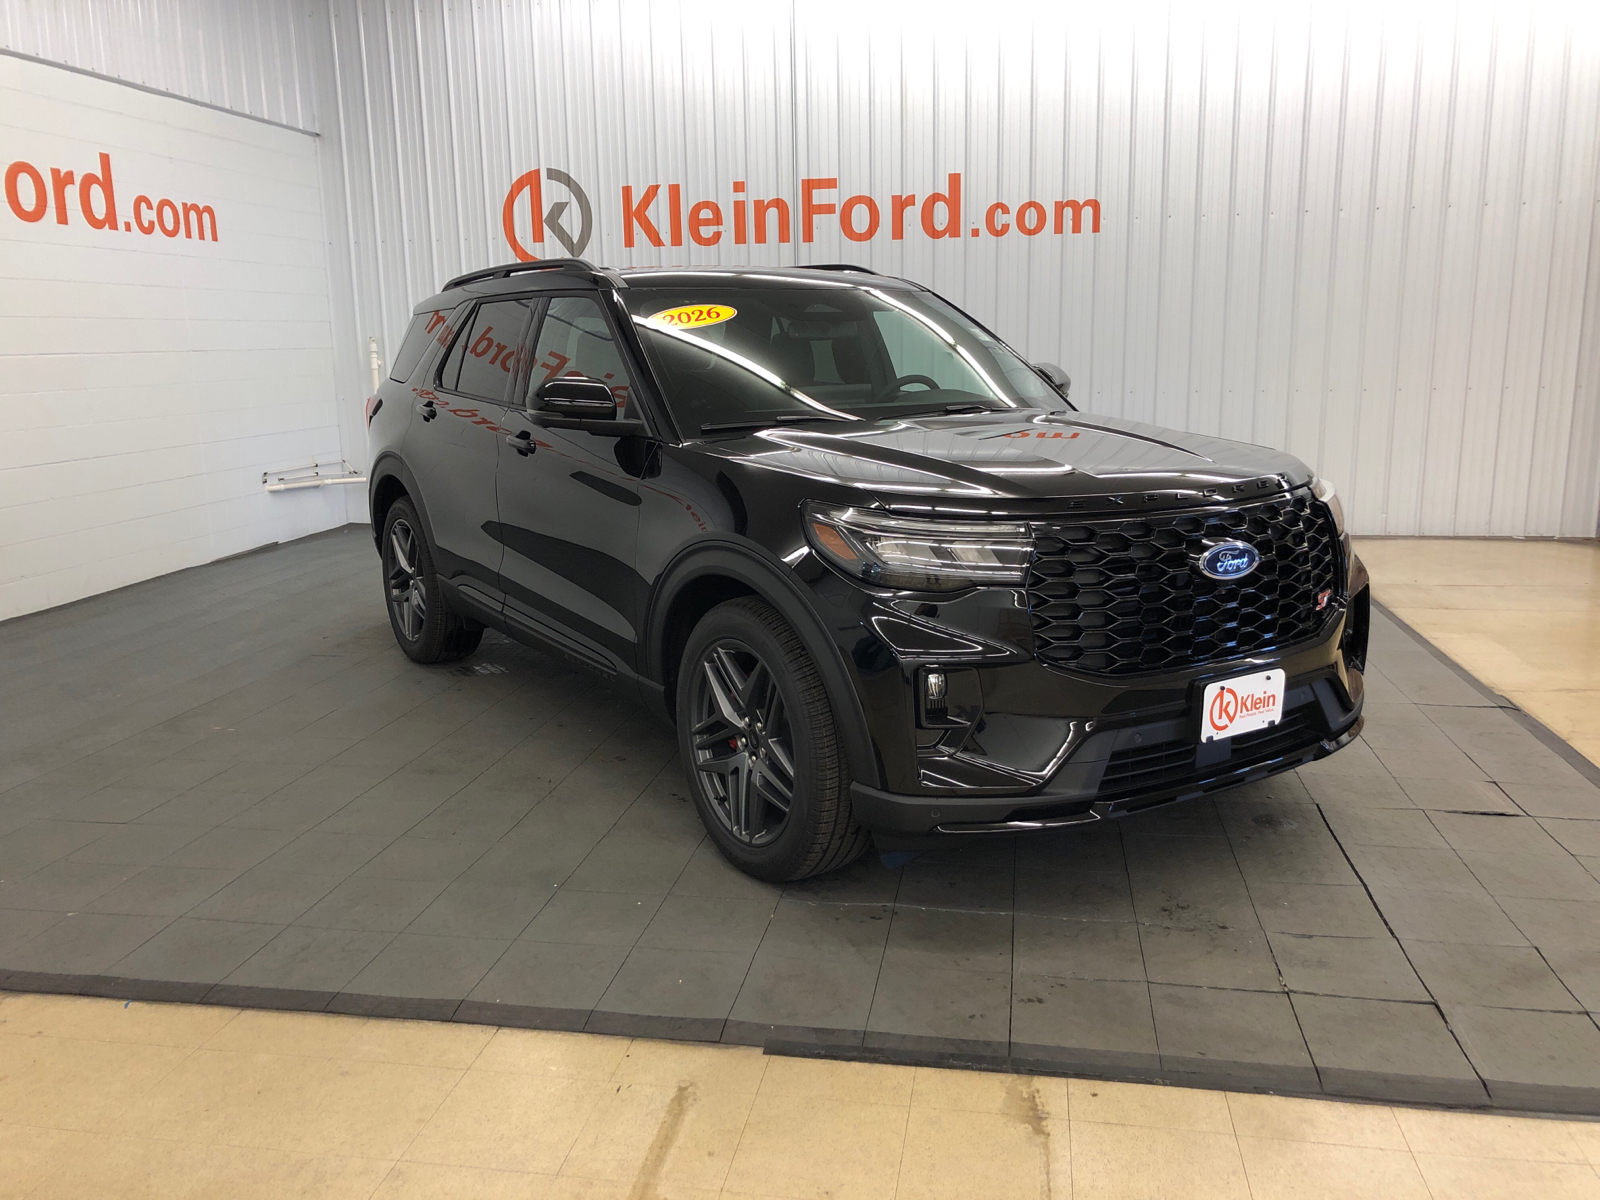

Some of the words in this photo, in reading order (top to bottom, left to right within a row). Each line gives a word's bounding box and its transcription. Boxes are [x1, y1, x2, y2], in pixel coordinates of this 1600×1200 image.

[4, 152, 218, 242] ord.com
[621, 173, 1101, 248] KleinFord.com
[662, 306, 721, 326] 2026
[1216, 549, 1249, 572] Ford
[1240, 691, 1276, 713] Klein
